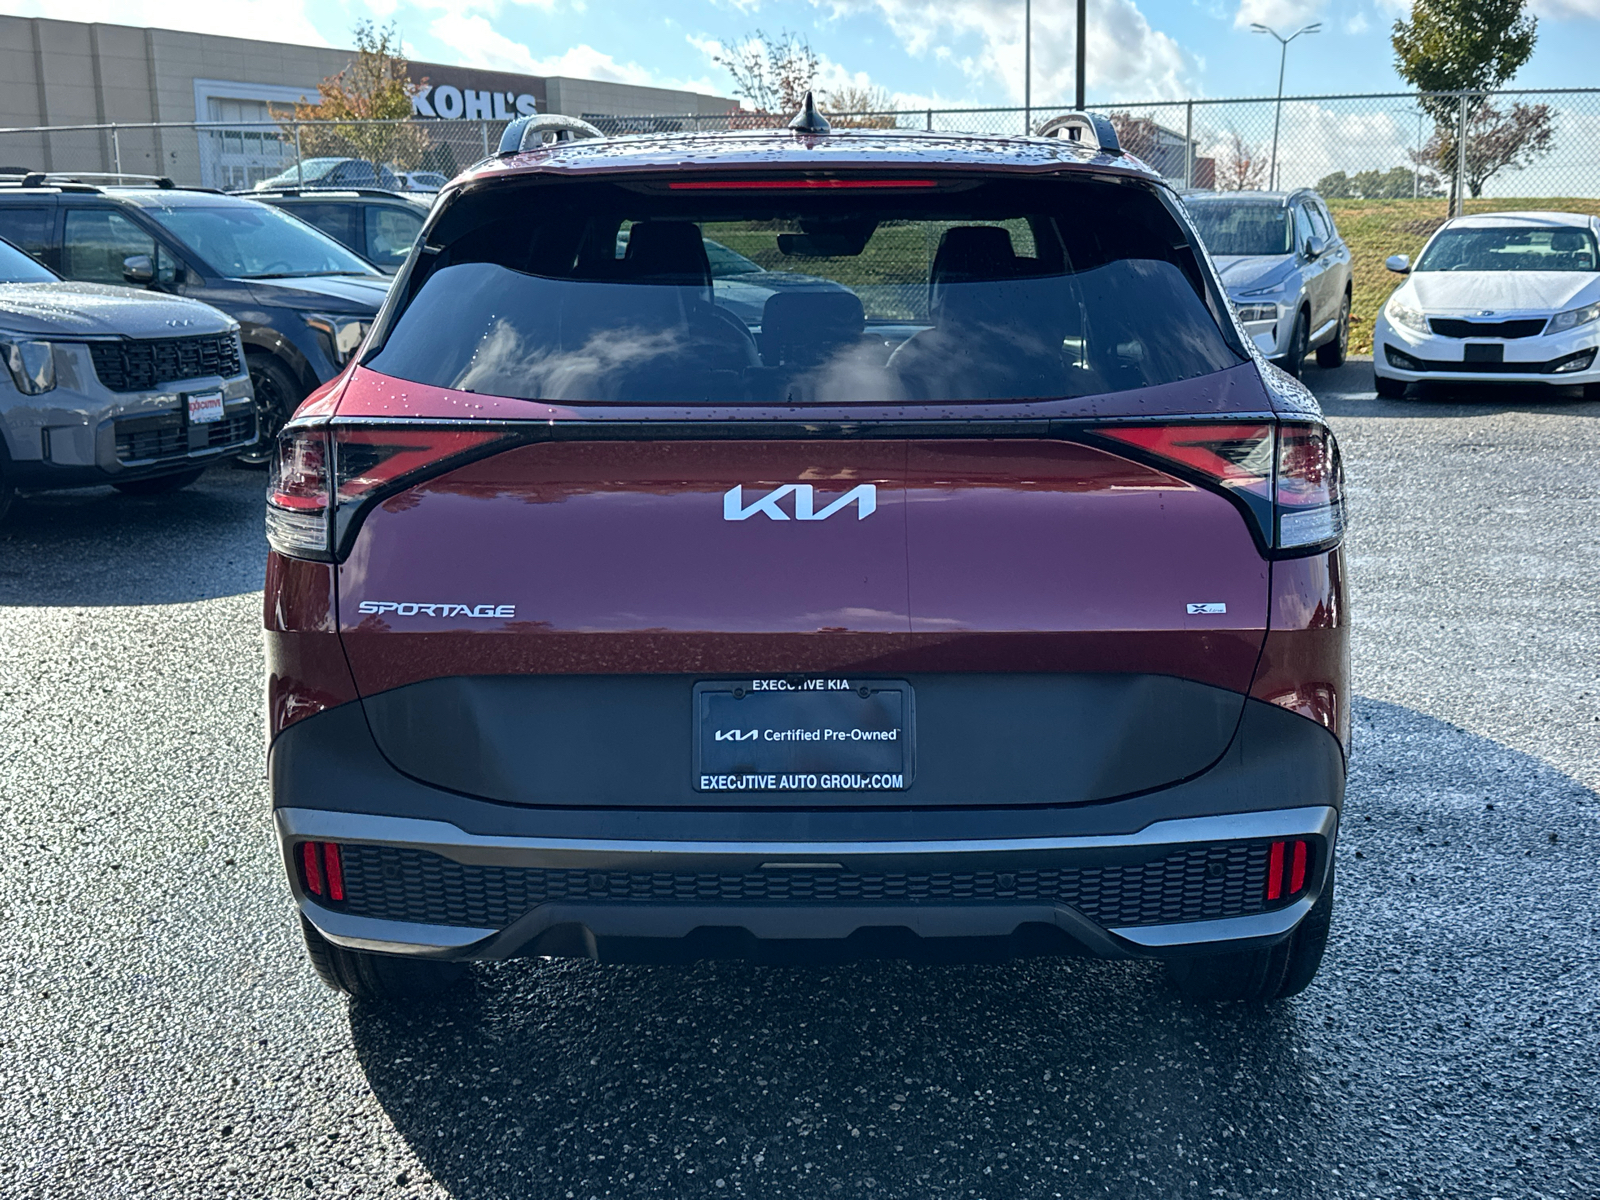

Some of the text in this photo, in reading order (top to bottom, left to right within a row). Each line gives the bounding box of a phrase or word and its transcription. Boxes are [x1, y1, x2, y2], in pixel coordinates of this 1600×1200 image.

[403, 84, 537, 119] KOHL'S
[723, 484, 877, 521] KIA
[358, 601, 516, 618] SPORTAGE
[752, 679, 850, 690] EXECIVE KIA
[715, 728, 897, 741] KIA Certified Pre-Owned
[700, 775, 777, 789] EXECUTIVE
[779, 774, 818, 789] AUTO
